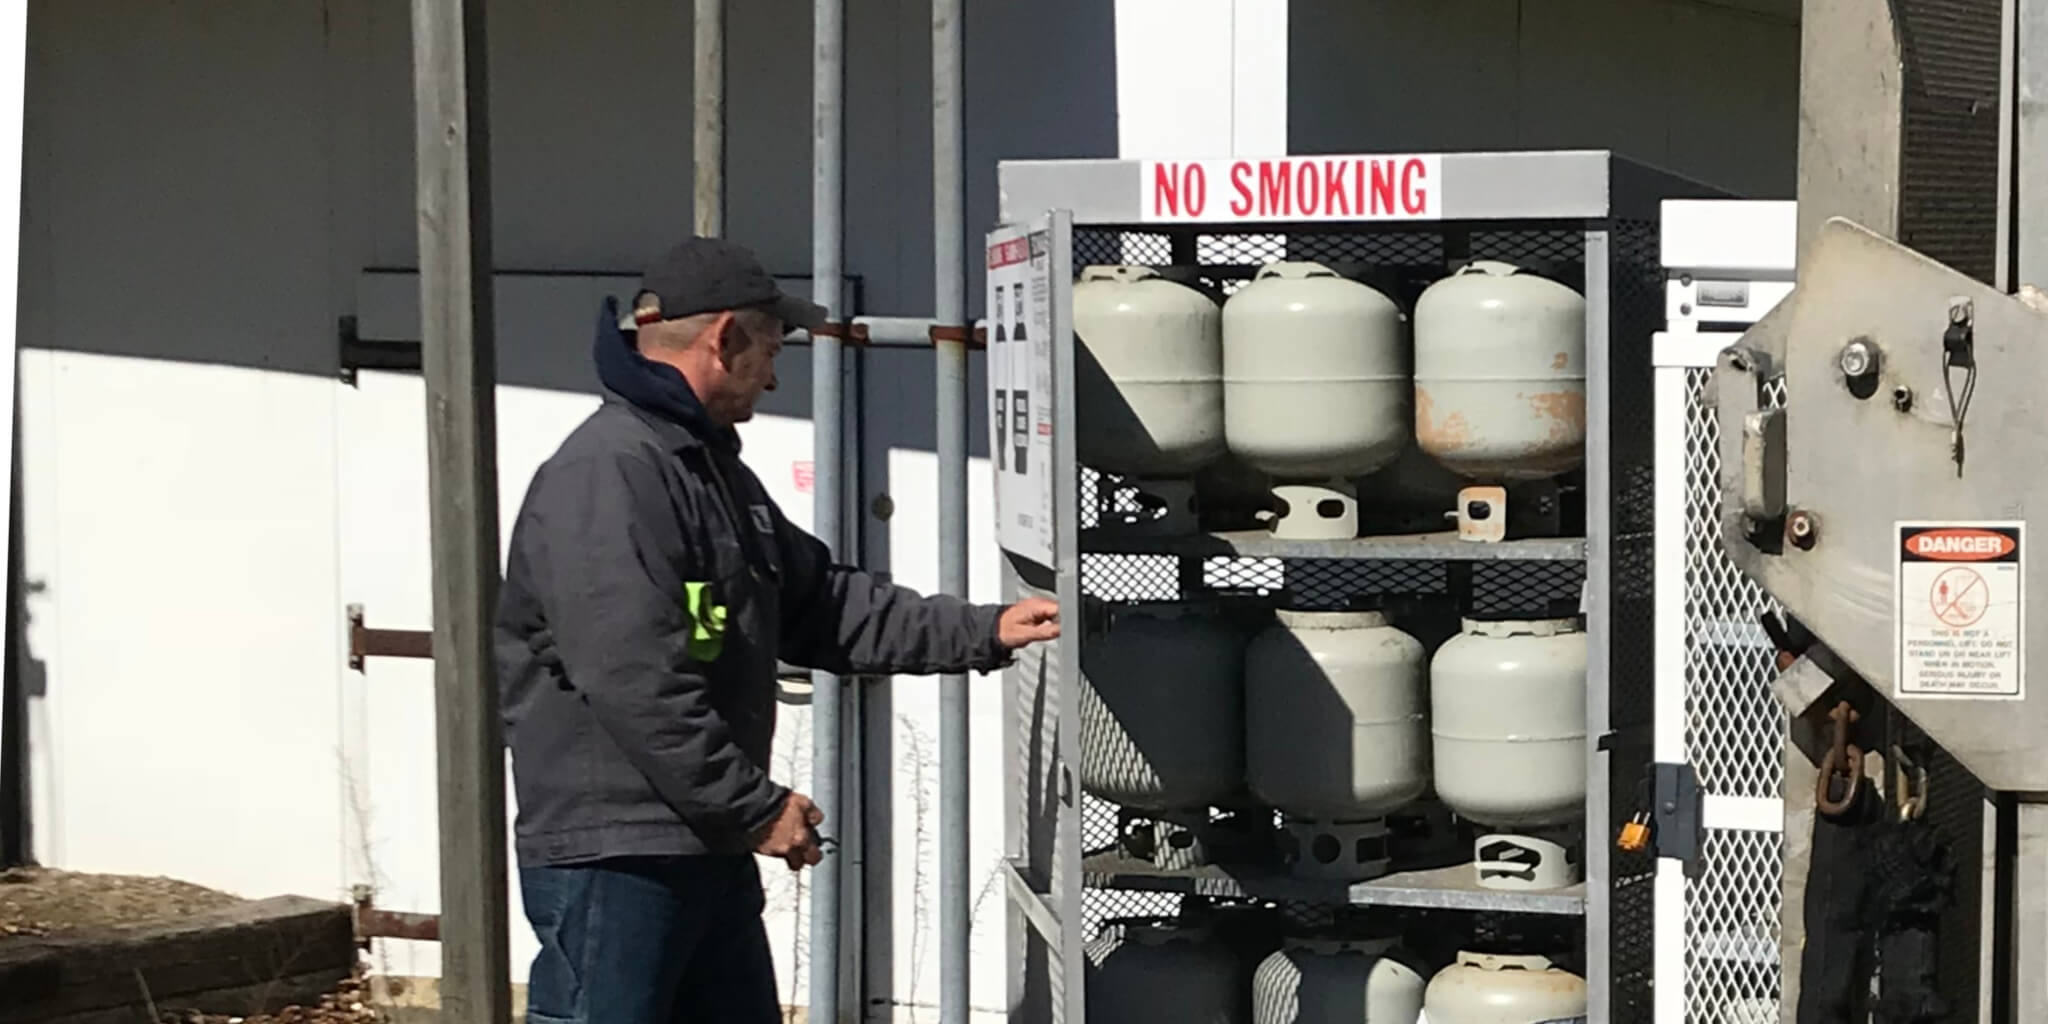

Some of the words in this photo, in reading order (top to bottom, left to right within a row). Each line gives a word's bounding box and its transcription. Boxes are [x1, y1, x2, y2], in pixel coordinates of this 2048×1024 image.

[1155, 162, 1206, 217] NO
[1230, 158, 1426, 217] SMOKING
[1918, 536, 2003, 553] DANGER
[1919, 680, 1947, 688] DEATH
